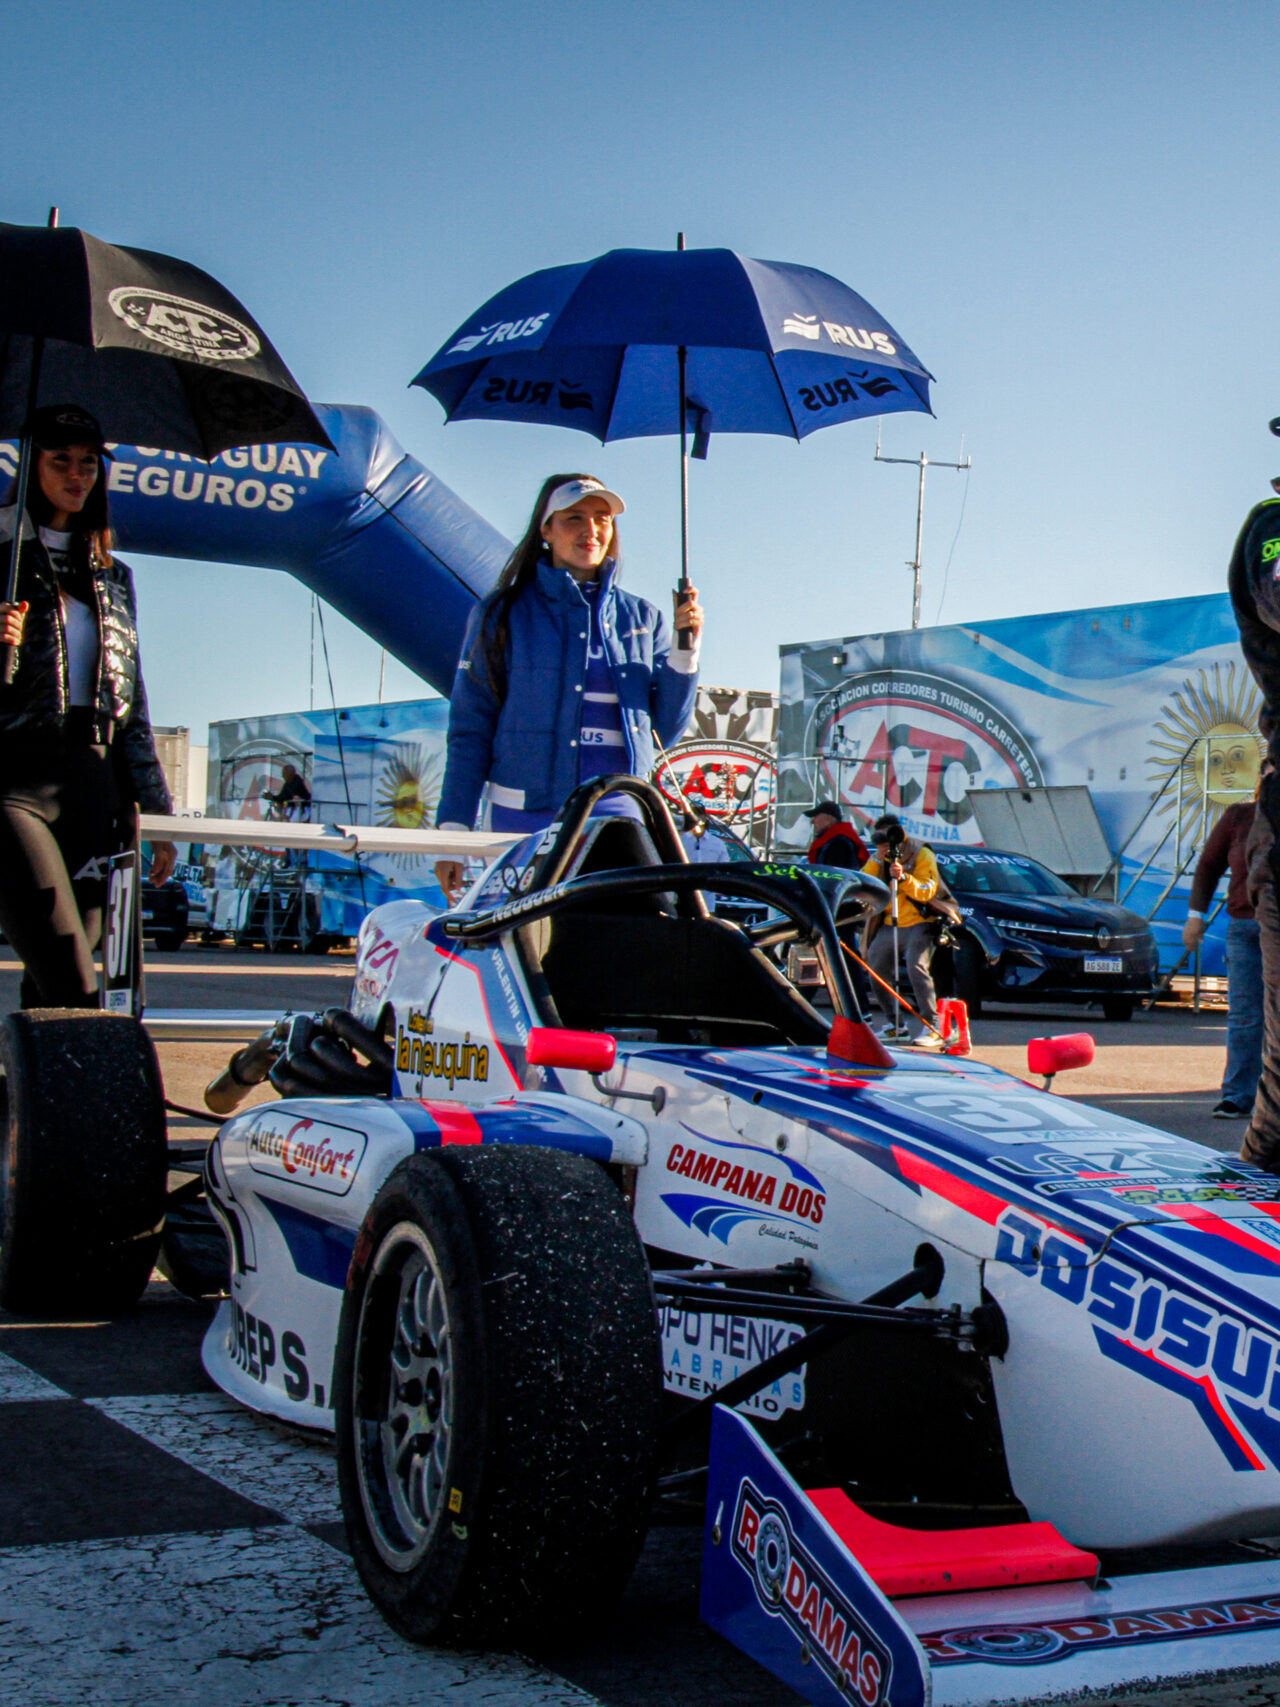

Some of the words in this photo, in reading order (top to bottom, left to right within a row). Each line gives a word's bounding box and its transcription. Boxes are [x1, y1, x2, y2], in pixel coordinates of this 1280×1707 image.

[146, 303, 223, 342] ACTC
[159, 327, 221, 349] ARGENTINA
[486, 312, 550, 345] RUS
[822, 321, 896, 356] RUS
[107, 461, 295, 512] EGUROS
[582, 731, 604, 743] US
[872, 681, 938, 701] CORREDORES
[940, 691, 985, 724] TURISMO
[985, 719, 1038, 788] CARRETERA
[848, 719, 982, 826] ACTC
[491, 948, 521, 1019] VALENTIN
[666, 1143, 777, 1207] CAMPANA
[778, 1182, 827, 1224] DOS
